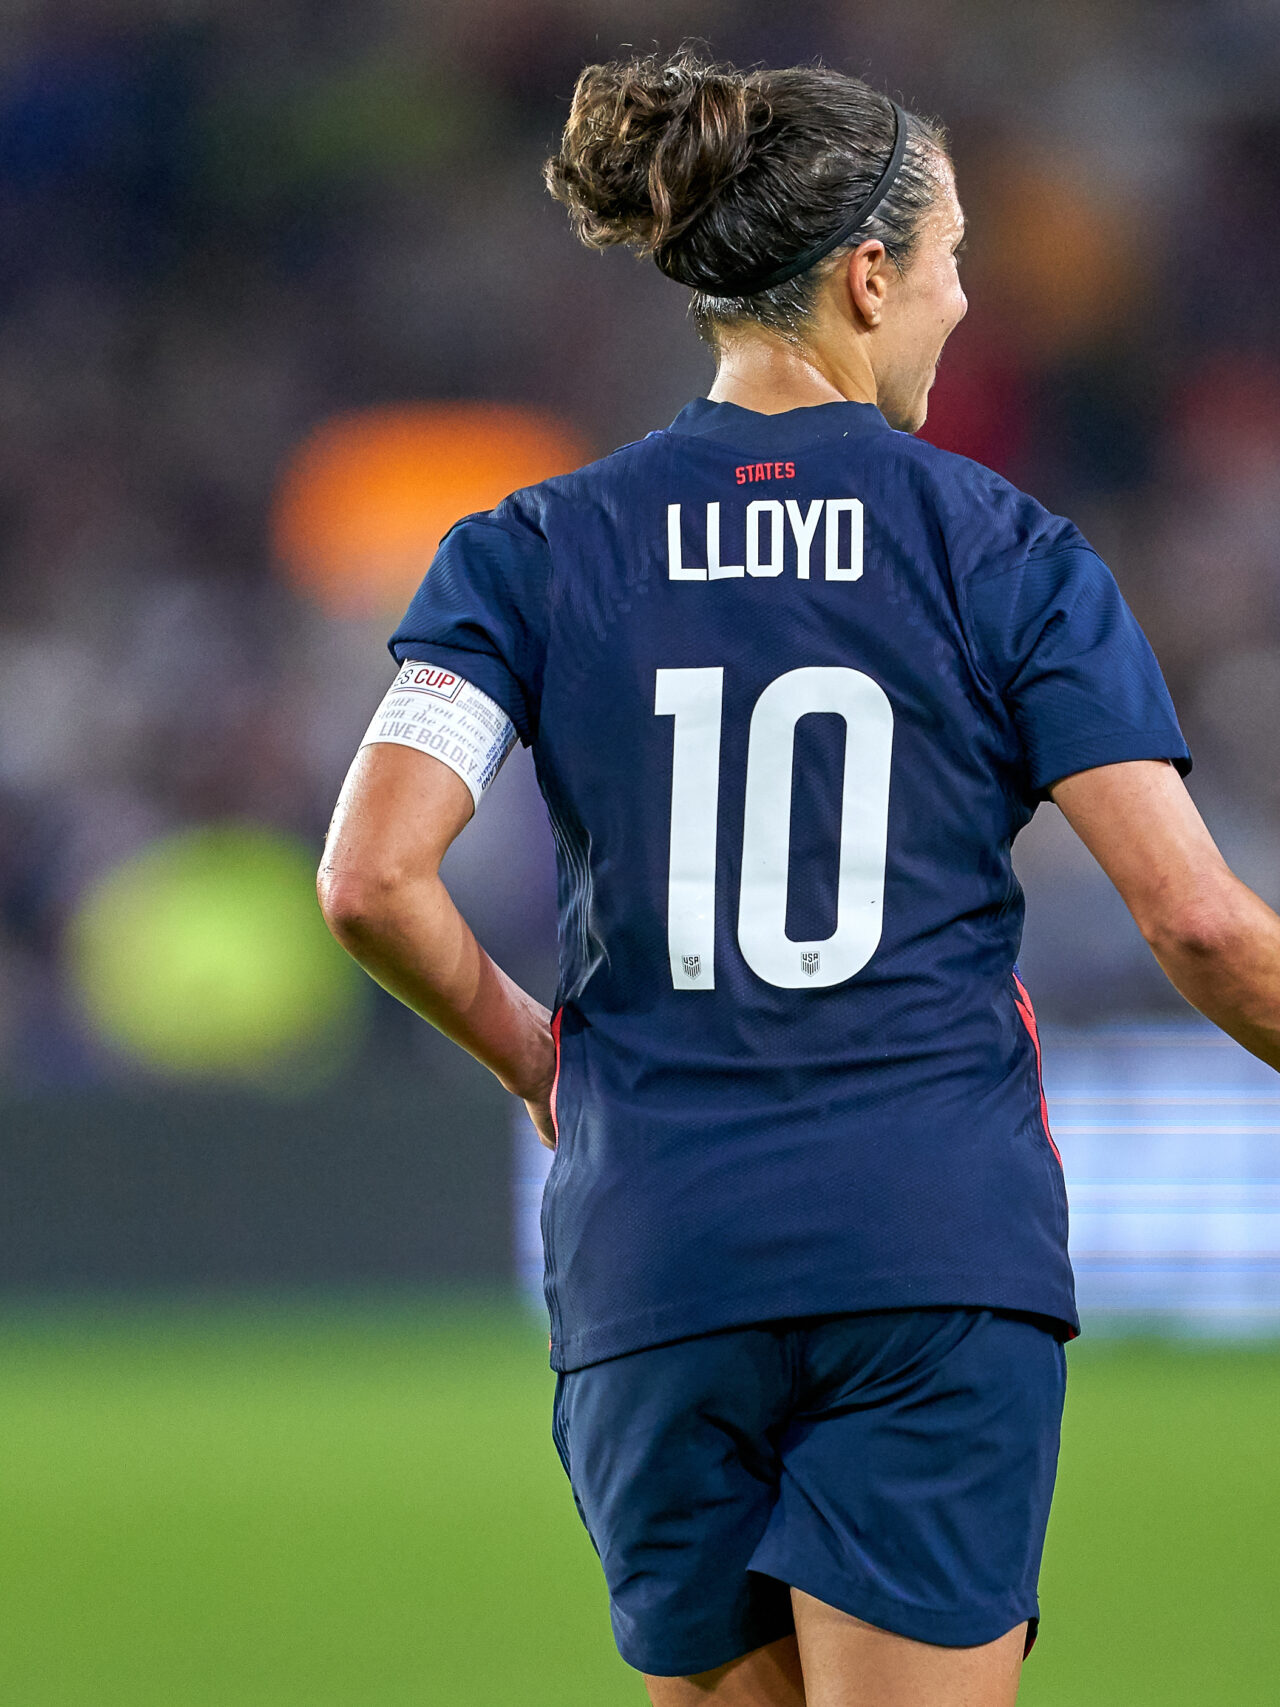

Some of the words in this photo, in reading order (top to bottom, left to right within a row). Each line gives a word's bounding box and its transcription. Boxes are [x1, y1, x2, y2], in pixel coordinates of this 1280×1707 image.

[735, 461, 796, 485] STATES
[667, 498, 864, 581] LLOYD
[414, 668, 456, 689] CUP
[379, 722, 416, 740] LIVE
[416, 727, 479, 776] BOLDLY
[654, 666, 894, 990] 10
[683, 956, 699, 966] USA
[802, 953, 819, 962] USA
